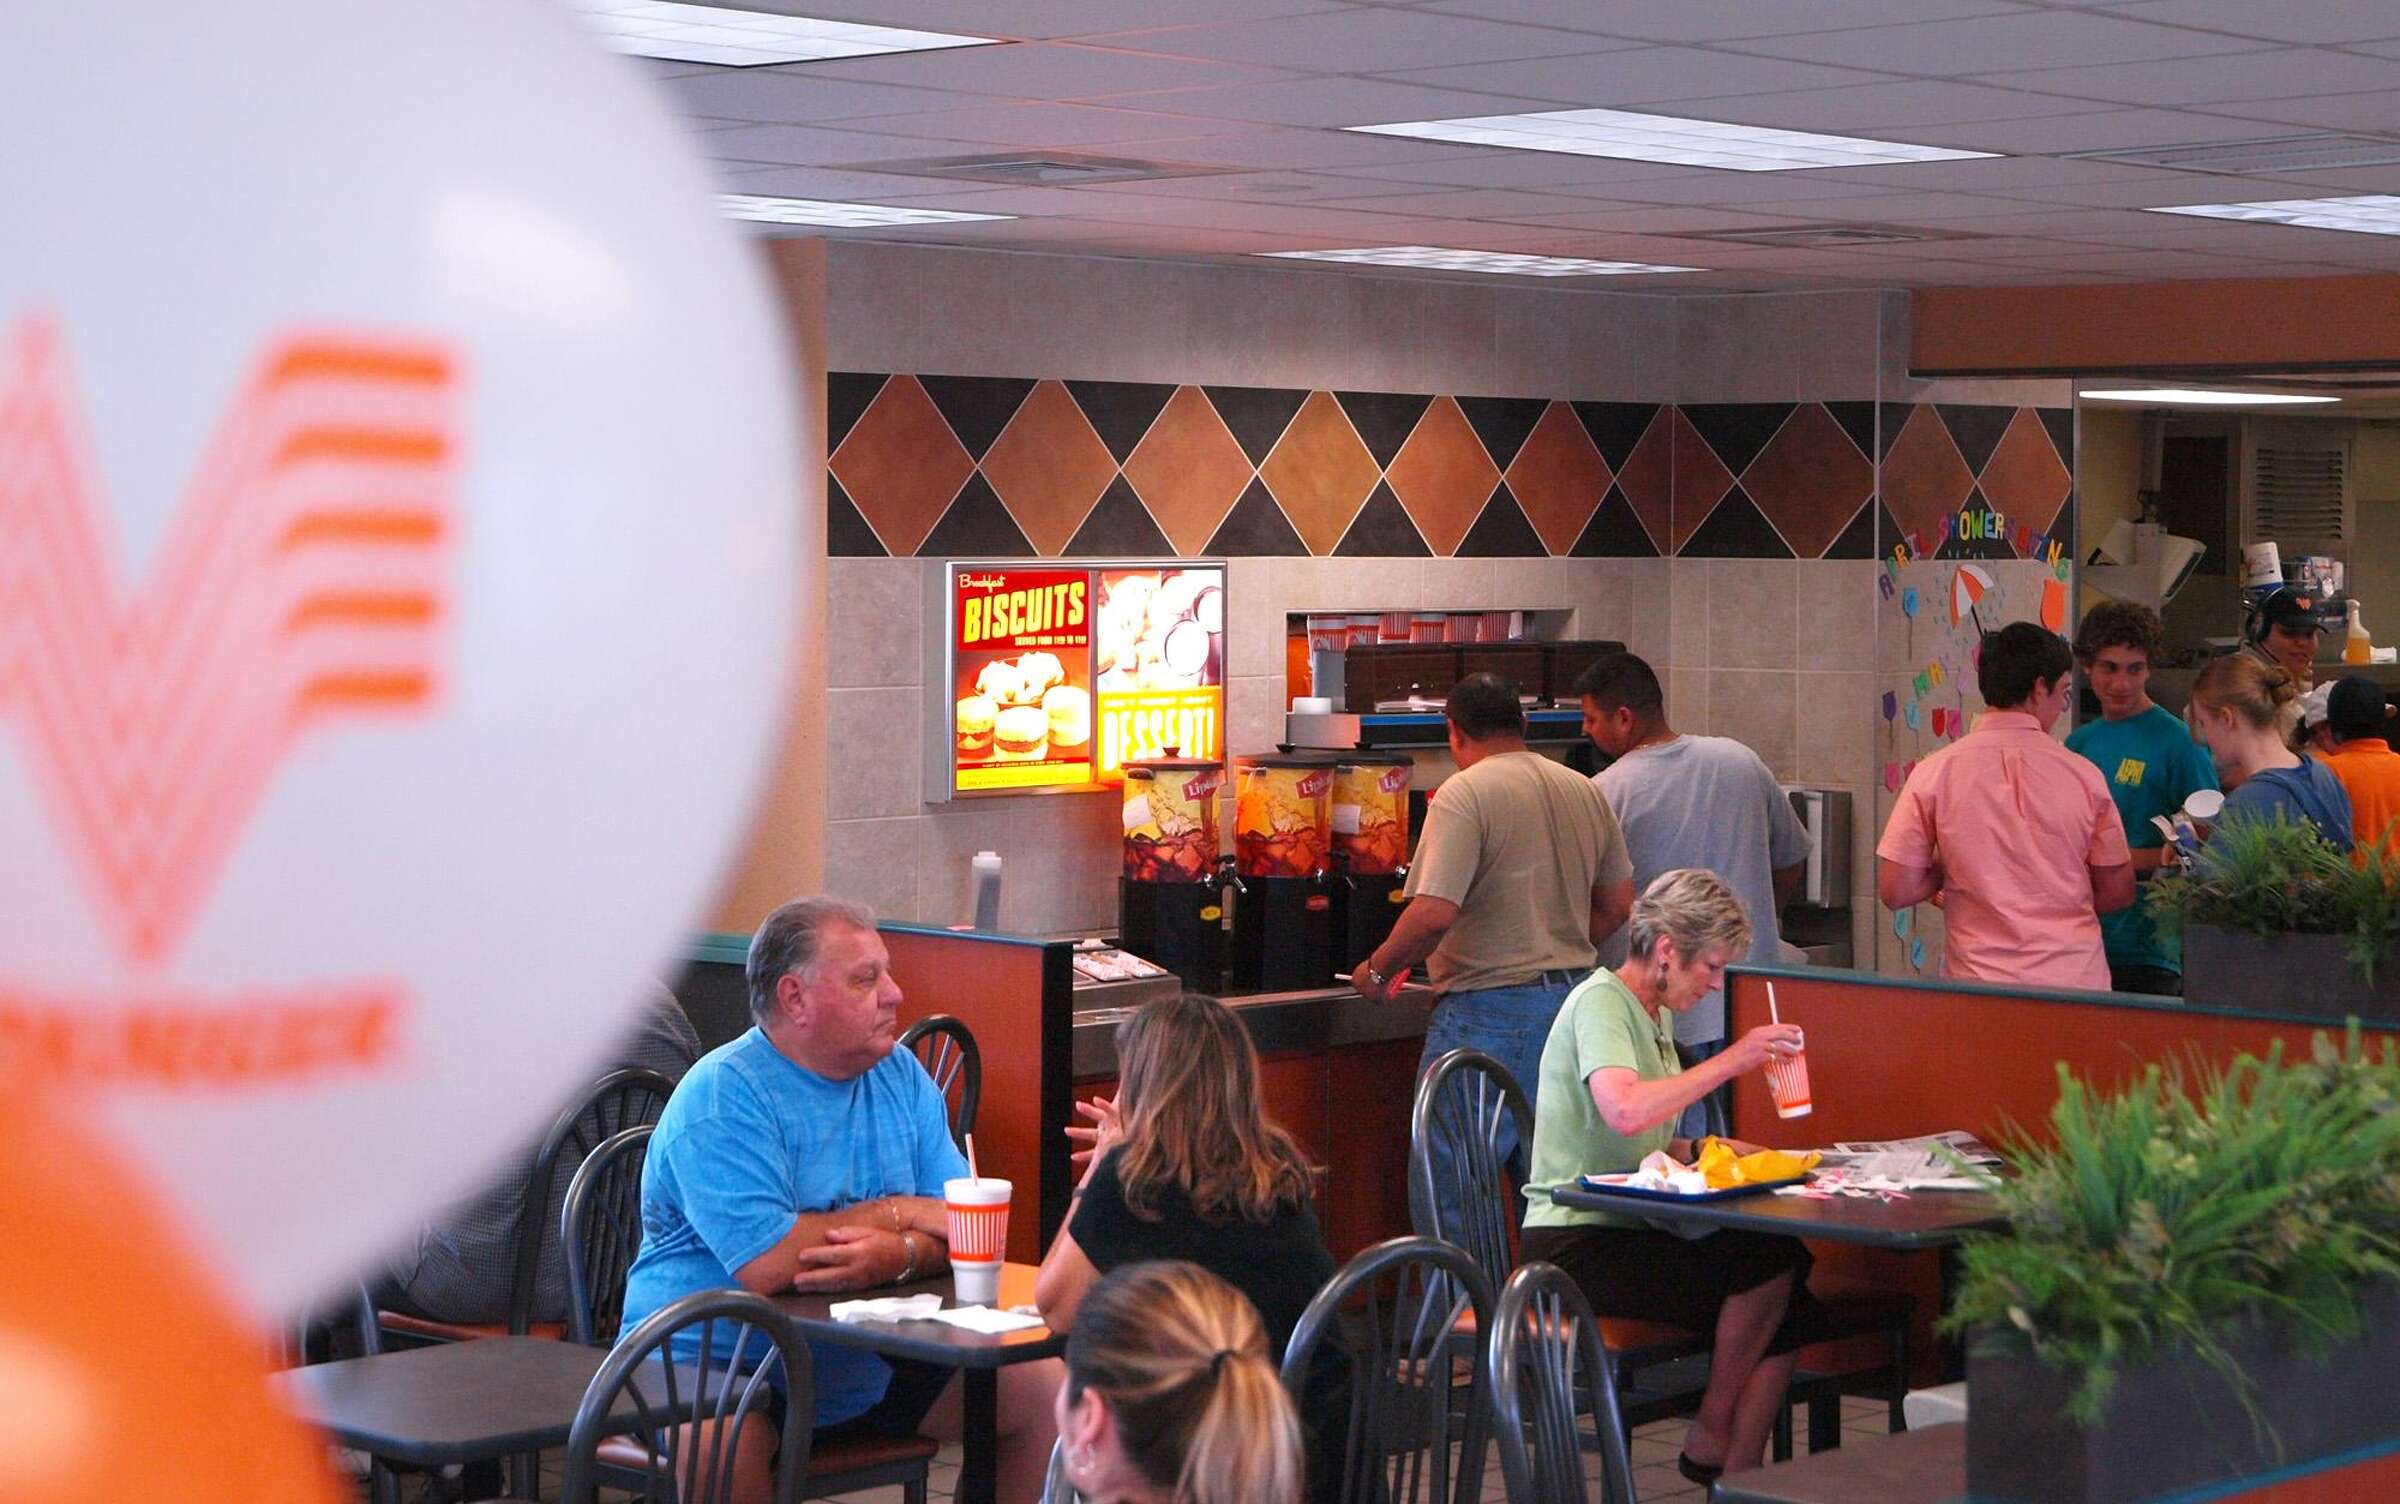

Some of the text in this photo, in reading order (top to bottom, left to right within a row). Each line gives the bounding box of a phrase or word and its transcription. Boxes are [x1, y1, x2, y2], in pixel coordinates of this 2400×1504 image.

[1938, 508, 2017, 545] SHOWERS
[958, 574, 1006, 593] Breakfast
[963, 581, 1085, 643] BISCUITS
